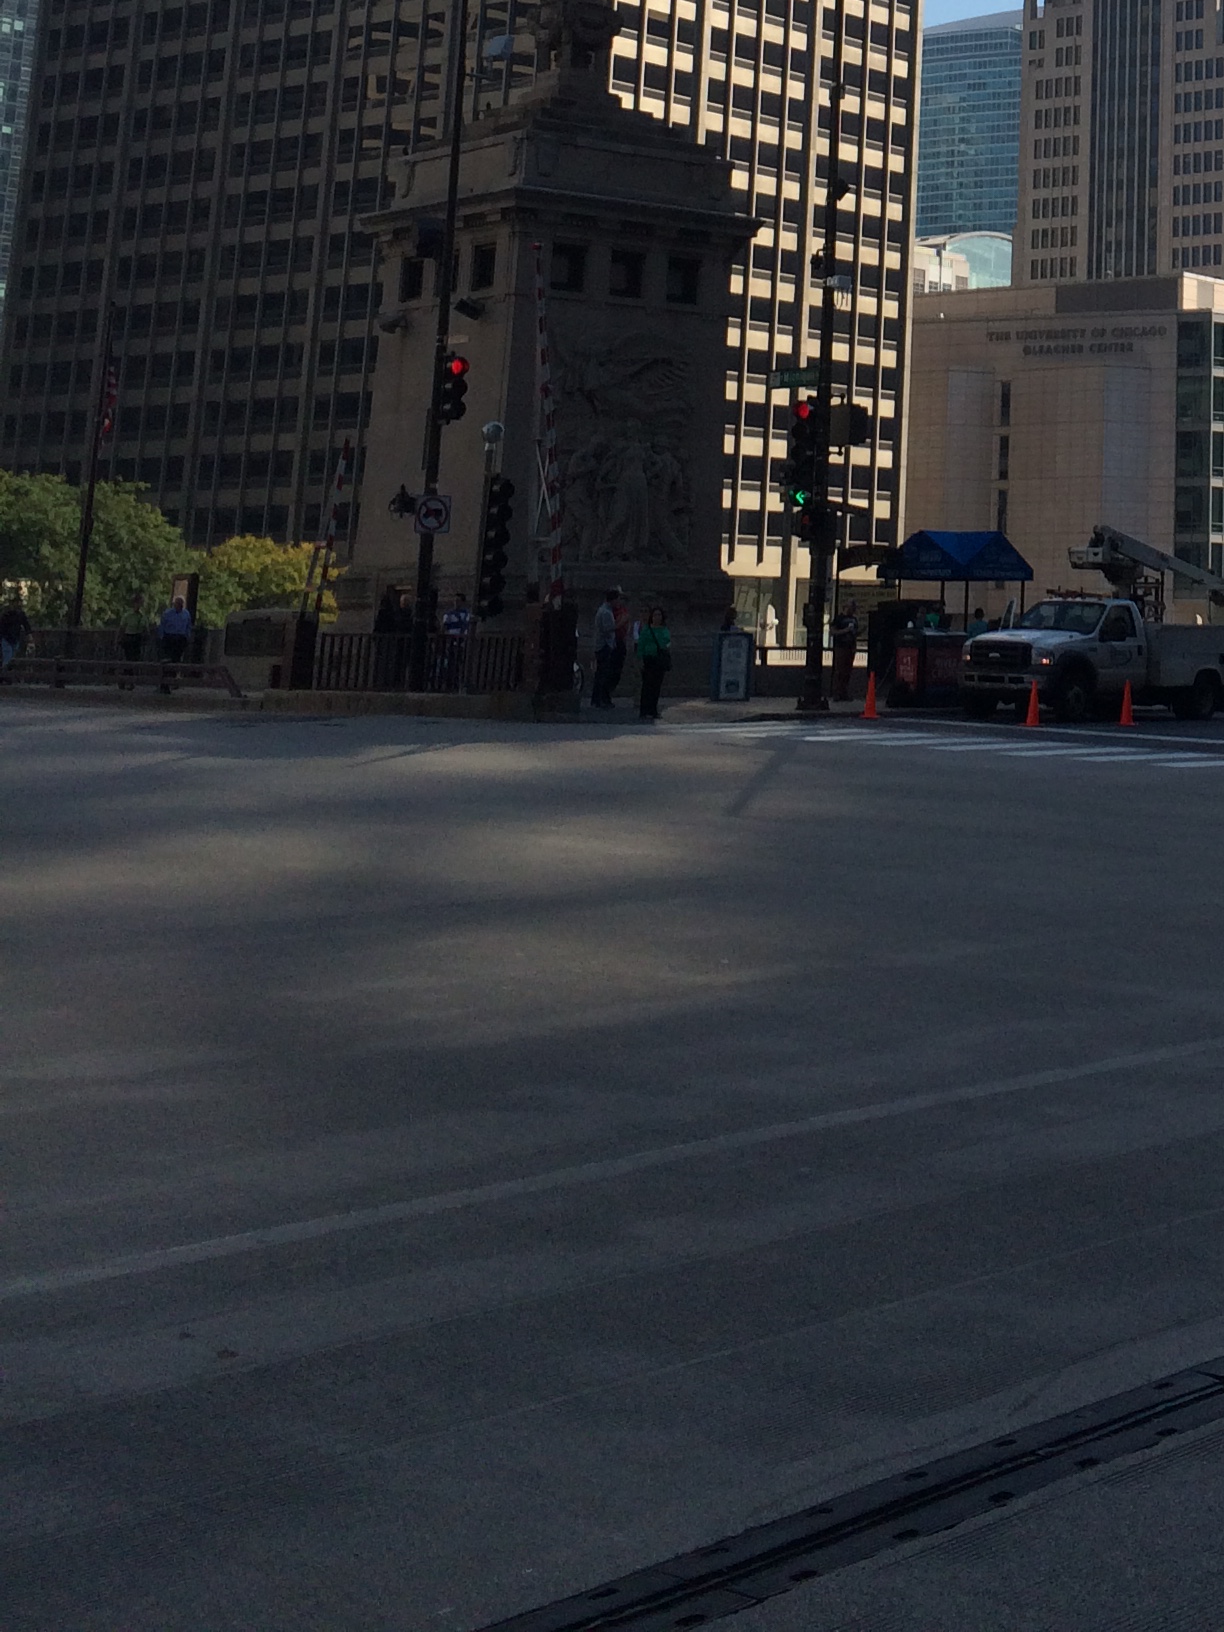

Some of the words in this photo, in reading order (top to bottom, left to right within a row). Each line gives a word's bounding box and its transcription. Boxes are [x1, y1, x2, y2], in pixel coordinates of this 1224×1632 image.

[987, 330, 1011, 342] THE
[1016, 327, 1087, 341] UNIVERSITY
[1091, 327, 1107, 338] OF
[1111, 325, 1167, 339] CHICAGO
[1089, 341, 1134, 354] CENTER
